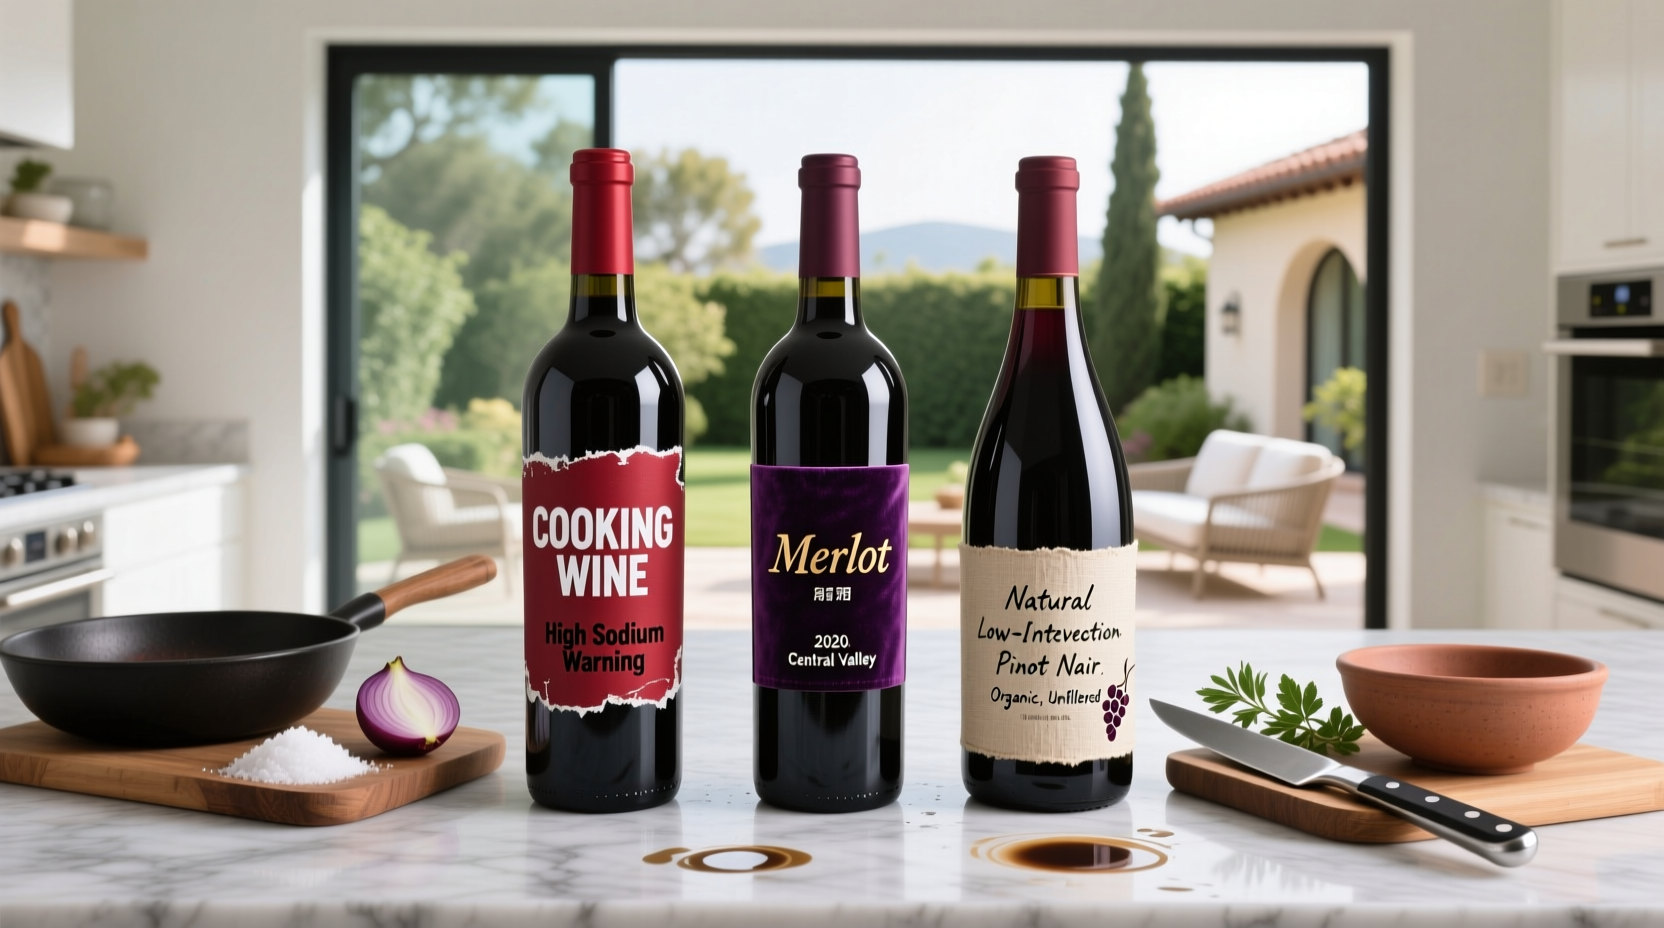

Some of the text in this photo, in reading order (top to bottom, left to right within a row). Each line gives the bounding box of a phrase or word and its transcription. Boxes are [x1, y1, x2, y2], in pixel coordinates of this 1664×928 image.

[532, 505, 673, 550] COOKING
[768, 532, 892, 574] Merlot
[556, 554, 649, 597] WINE
[1005, 584, 1094, 611] Natural
[545, 622, 664, 650] High Sodium
[562, 650, 646, 676] Warning
[788, 651, 877, 669] Central Valley
[996, 650, 1050, 676] Pinot
[990, 686, 1043, 711] Organic,
